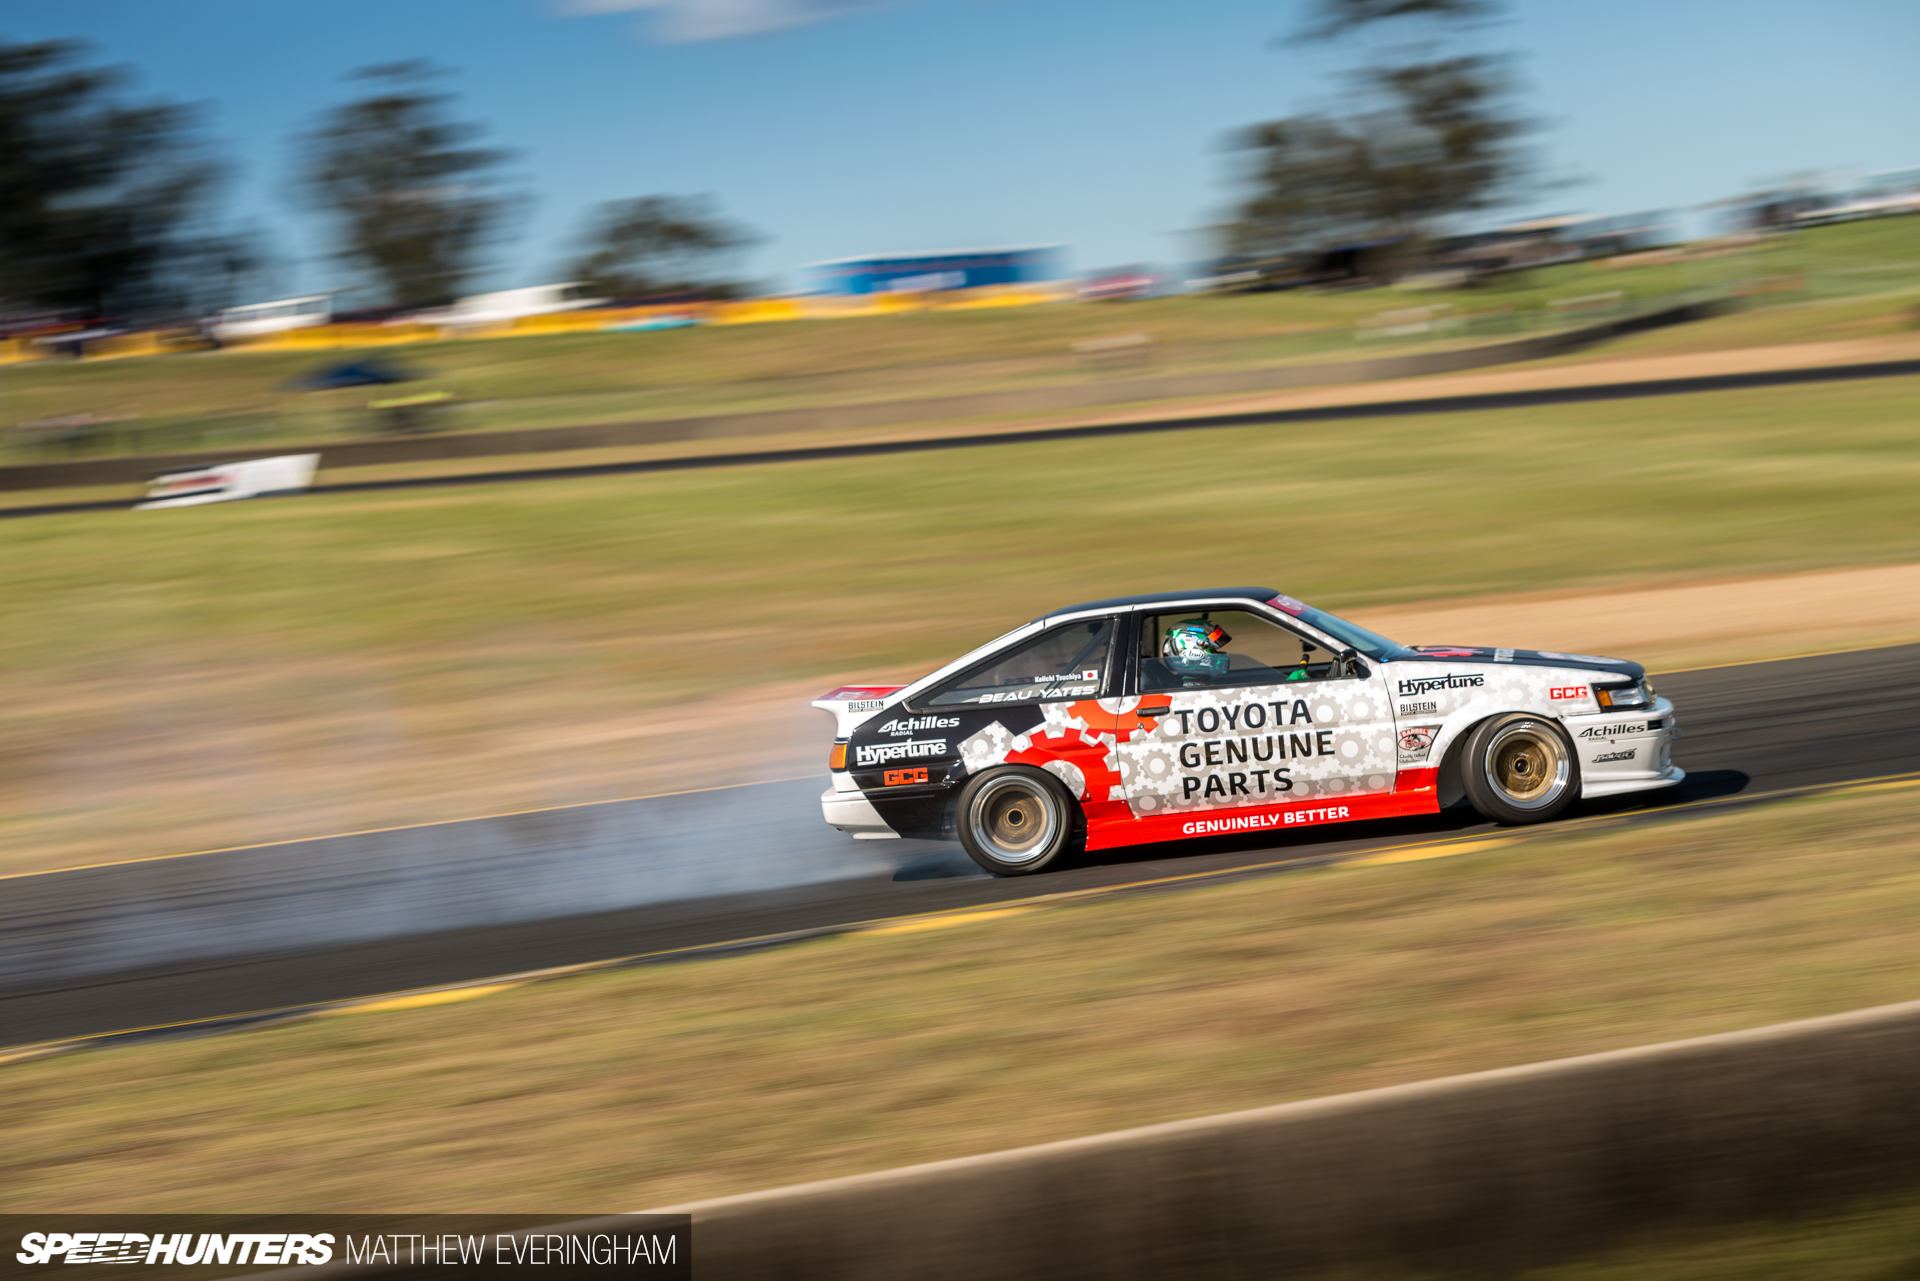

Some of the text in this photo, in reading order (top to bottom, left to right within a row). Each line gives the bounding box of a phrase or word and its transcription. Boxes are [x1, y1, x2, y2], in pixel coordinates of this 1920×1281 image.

[1056, 673, 1082, 682] Tsuchiya
[1398, 673, 1485, 697] Hypertune
[978, 685, 1098, 704] BEAU YATES
[1550, 686, 1588, 699] GCG
[848, 699, 884, 710] BILSTEIN
[1400, 701, 1437, 712] BILSTEIN
[878, 716, 960, 733] Achilles
[1174, 699, 1313, 735] TOYOTA
[890, 729, 914, 737] RADIAL
[1577, 724, 1645, 738] Achilles
[856, 738, 947, 766] Hypertune
[1179, 730, 1336, 768] GENUINE
[883, 767, 929, 786] GCG
[1182, 768, 1293, 799] PARTS
[1182, 806, 1350, 834] GENUINELY BETTER
